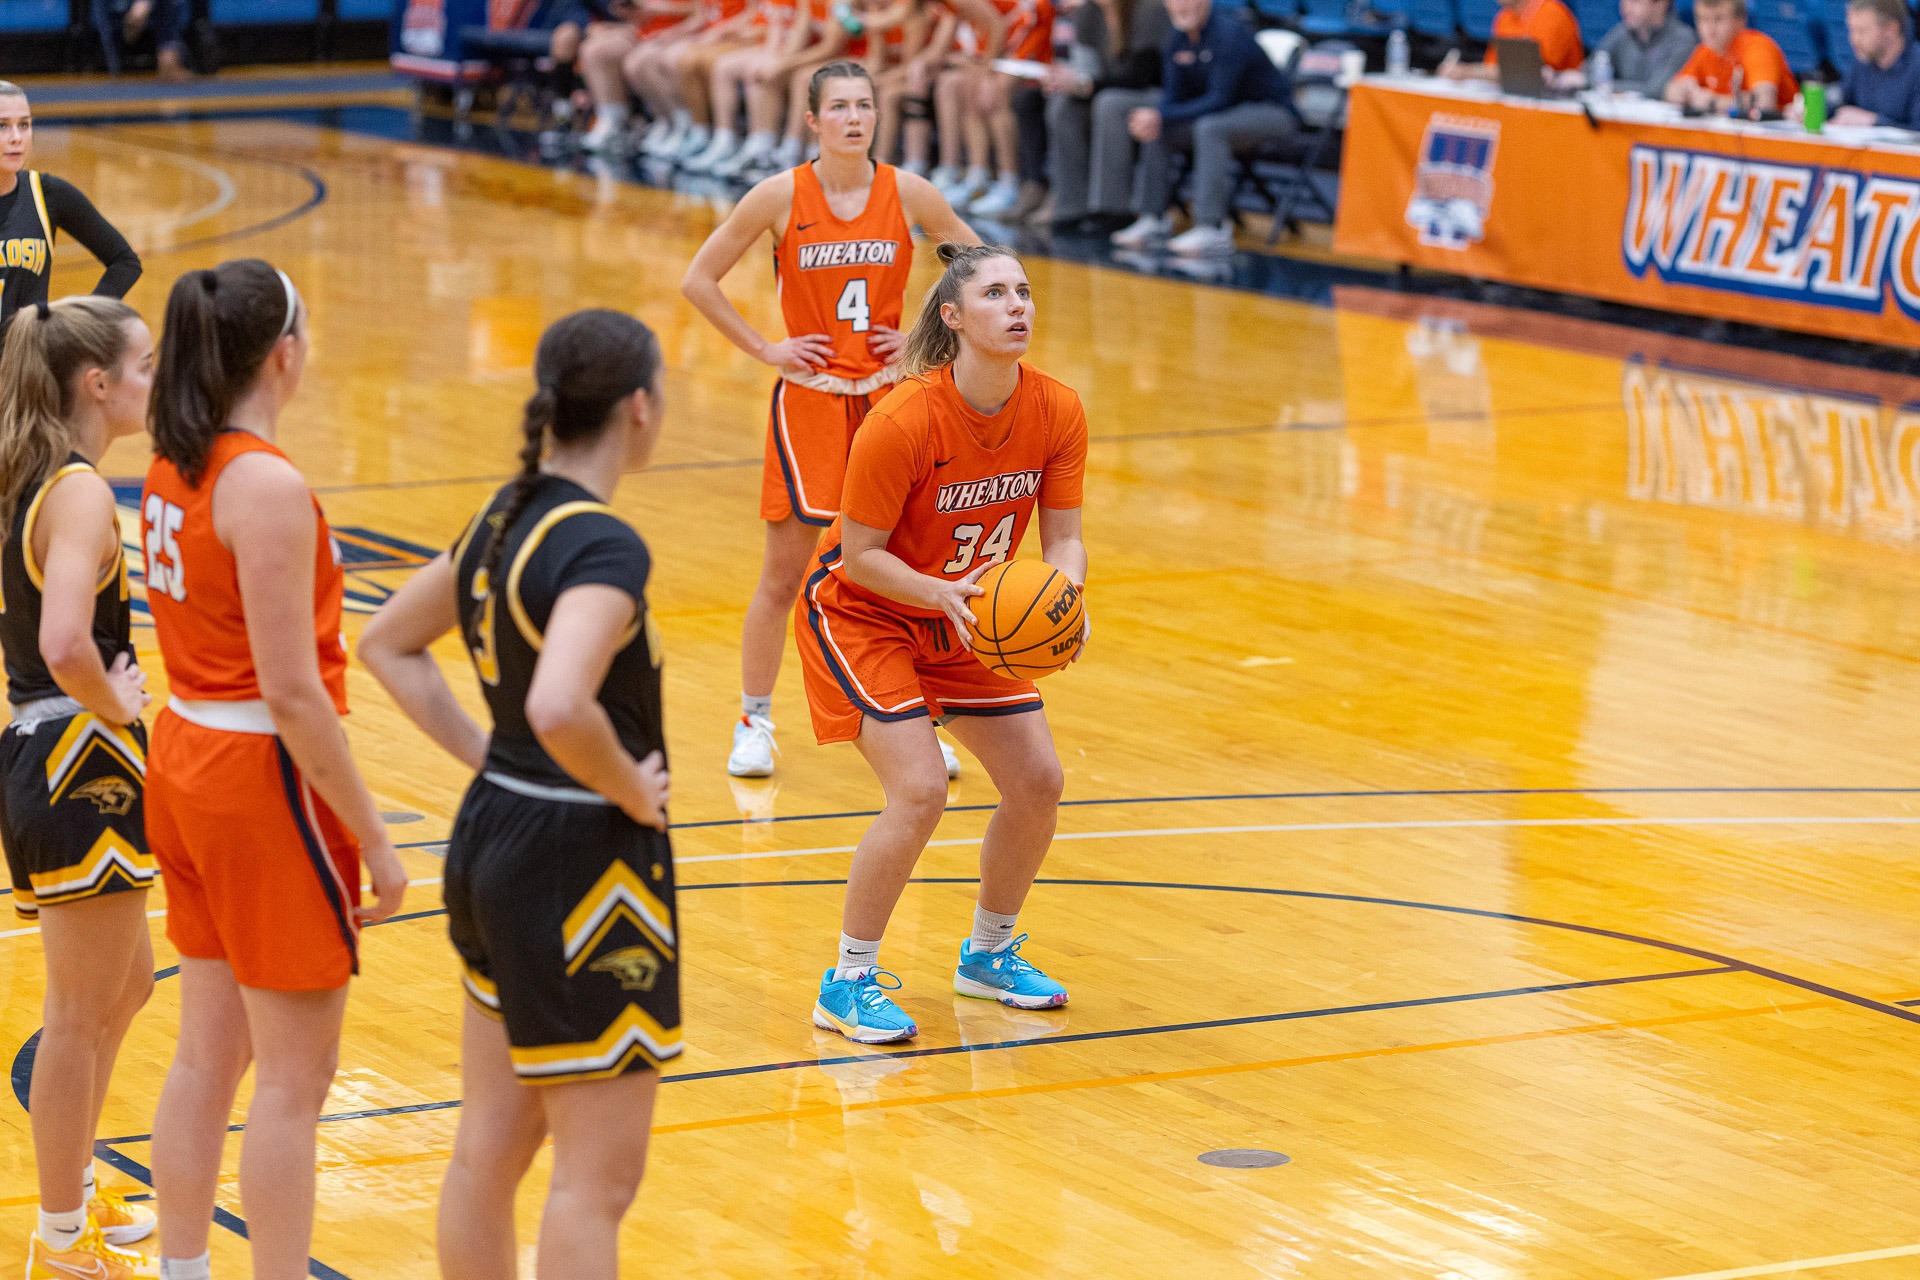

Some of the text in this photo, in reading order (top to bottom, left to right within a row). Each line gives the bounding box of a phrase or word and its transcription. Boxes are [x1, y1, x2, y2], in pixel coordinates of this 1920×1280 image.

[798, 239, 899, 271] WHEATON
[836, 278, 870, 333] 4
[936, 470, 1042, 513] WHEATON
[145, 492, 187, 603] 25
[942, 511, 1017, 574] 34
[1045, 580, 1079, 626] NCAA
